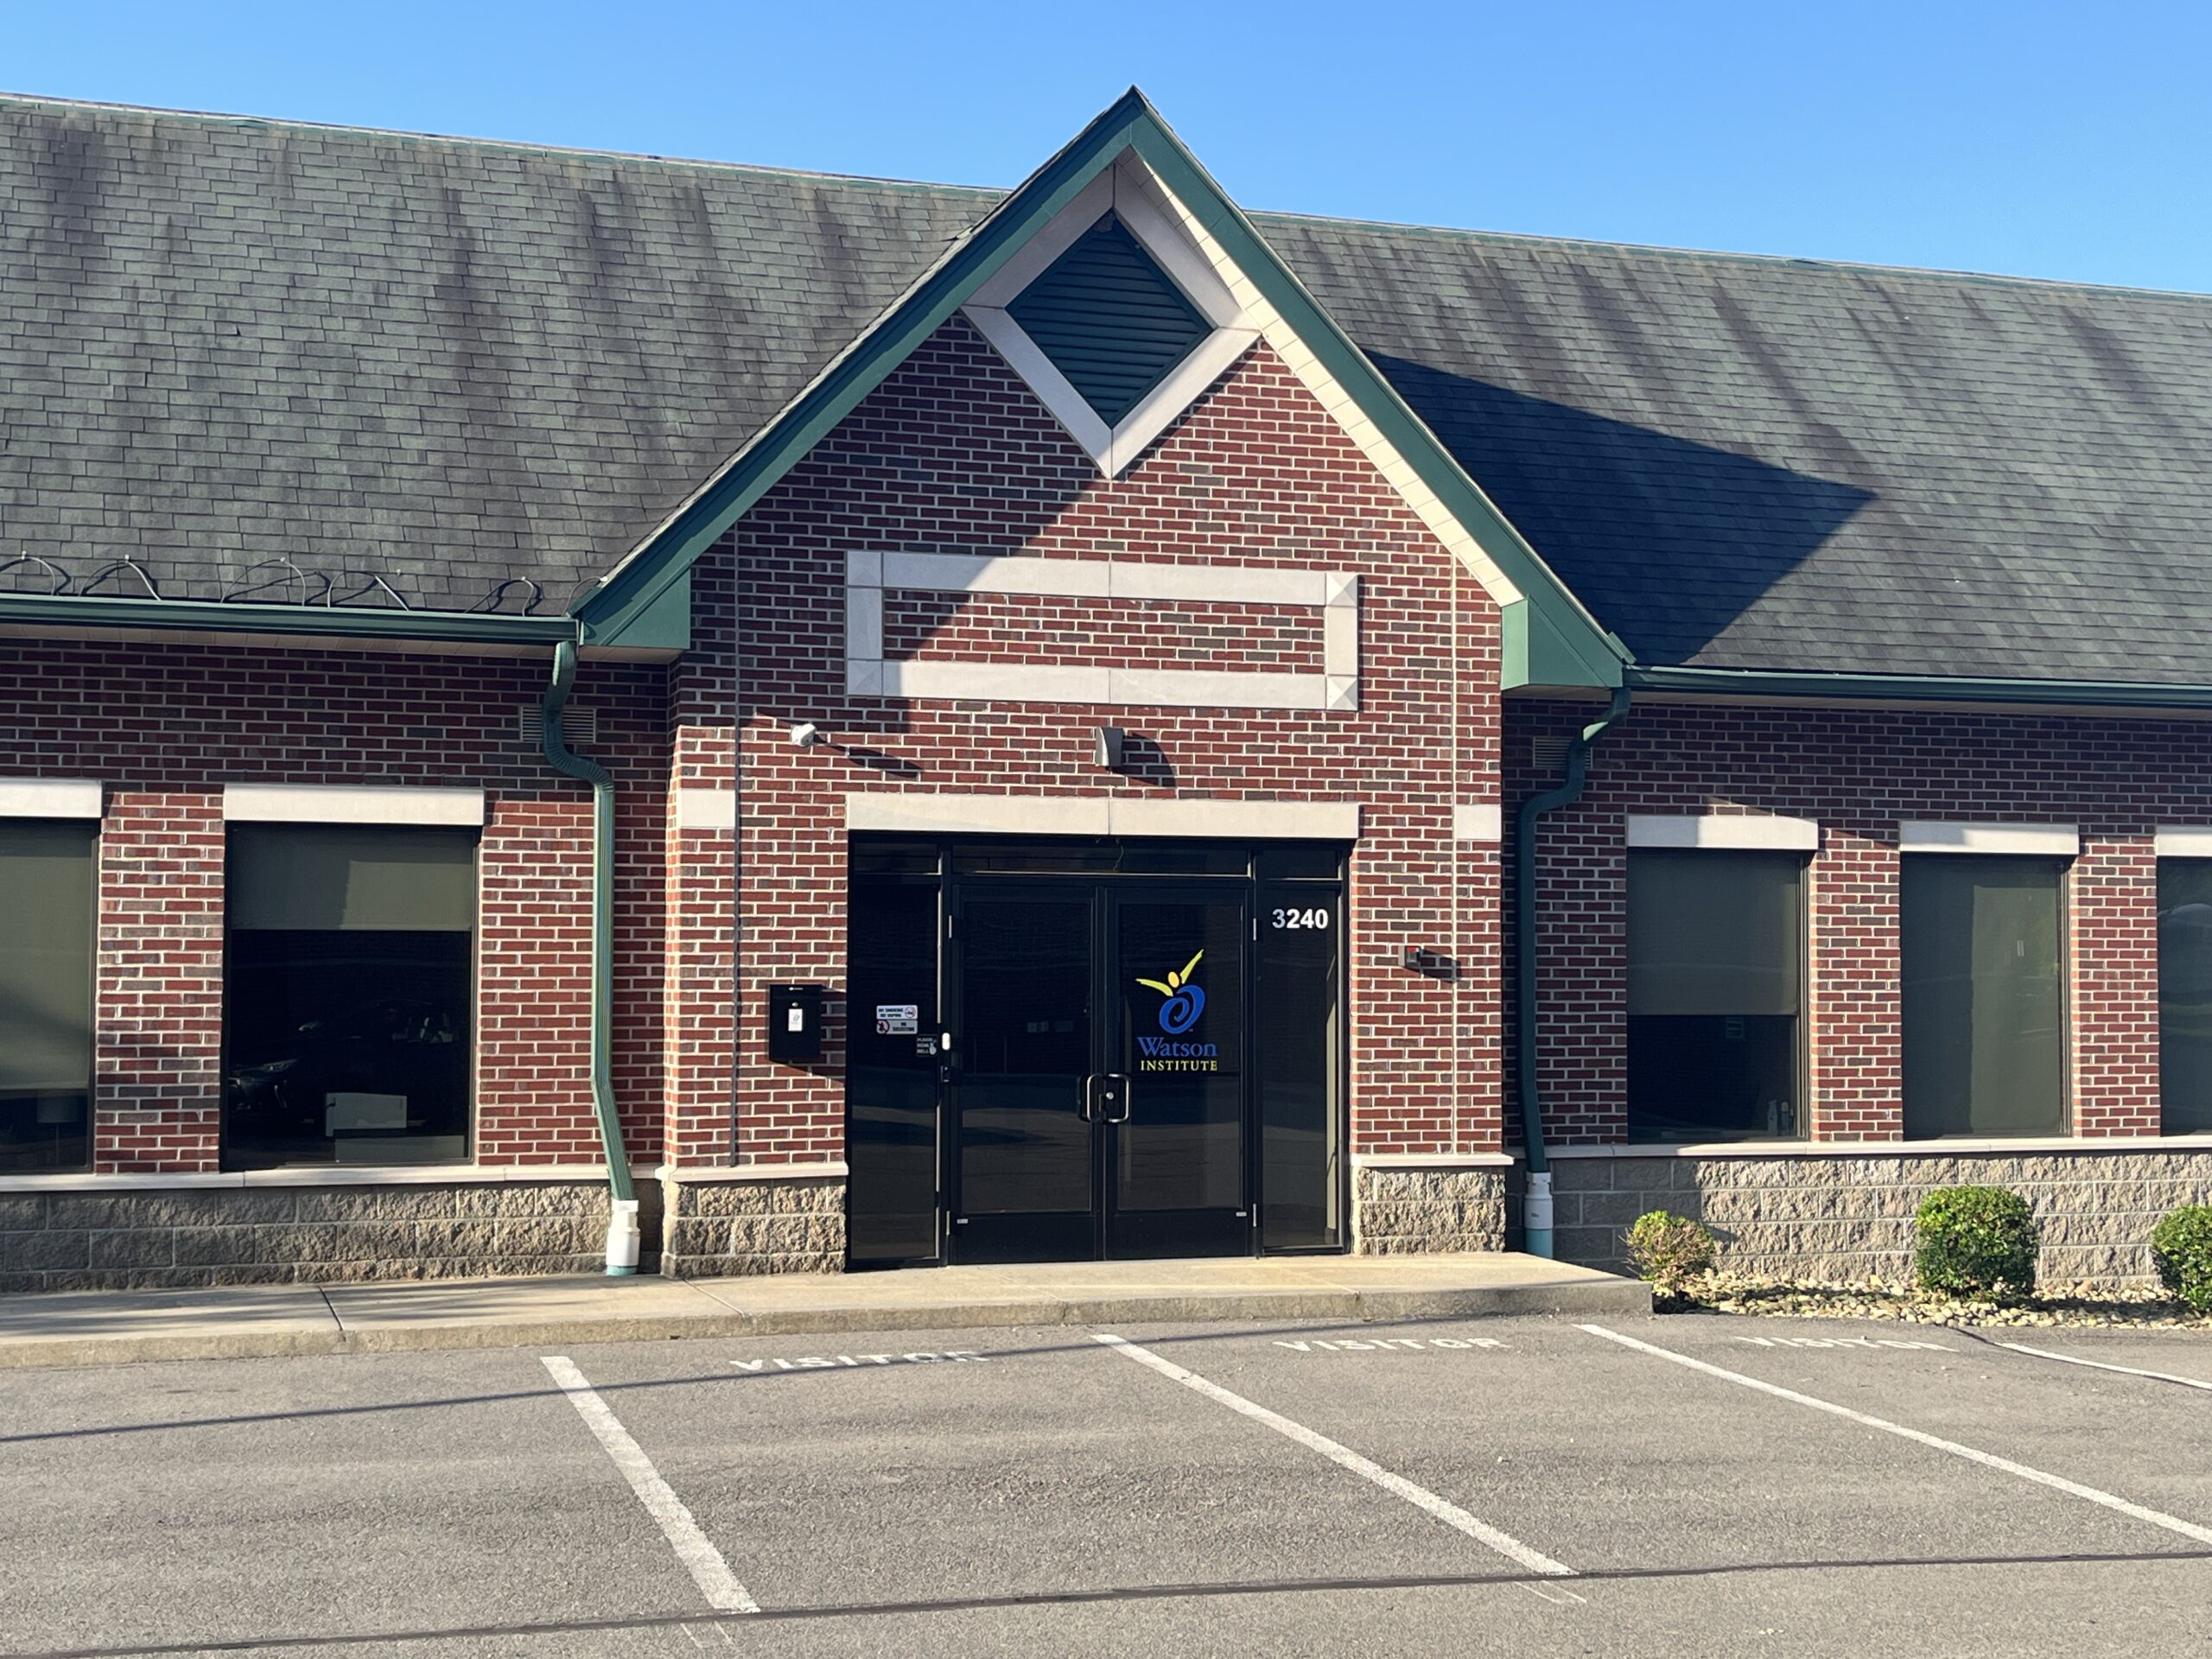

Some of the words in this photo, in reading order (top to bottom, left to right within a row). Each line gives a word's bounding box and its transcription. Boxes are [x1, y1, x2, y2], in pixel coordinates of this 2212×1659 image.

[1272, 908, 1328, 929] 3240
[1137, 1037, 1217, 1057] Watson
[1141, 1060, 1217, 1071] INSTITUTE
[1272, 1338, 1512, 1351] VISITOR
[728, 1351, 990, 1370] VISITOR
